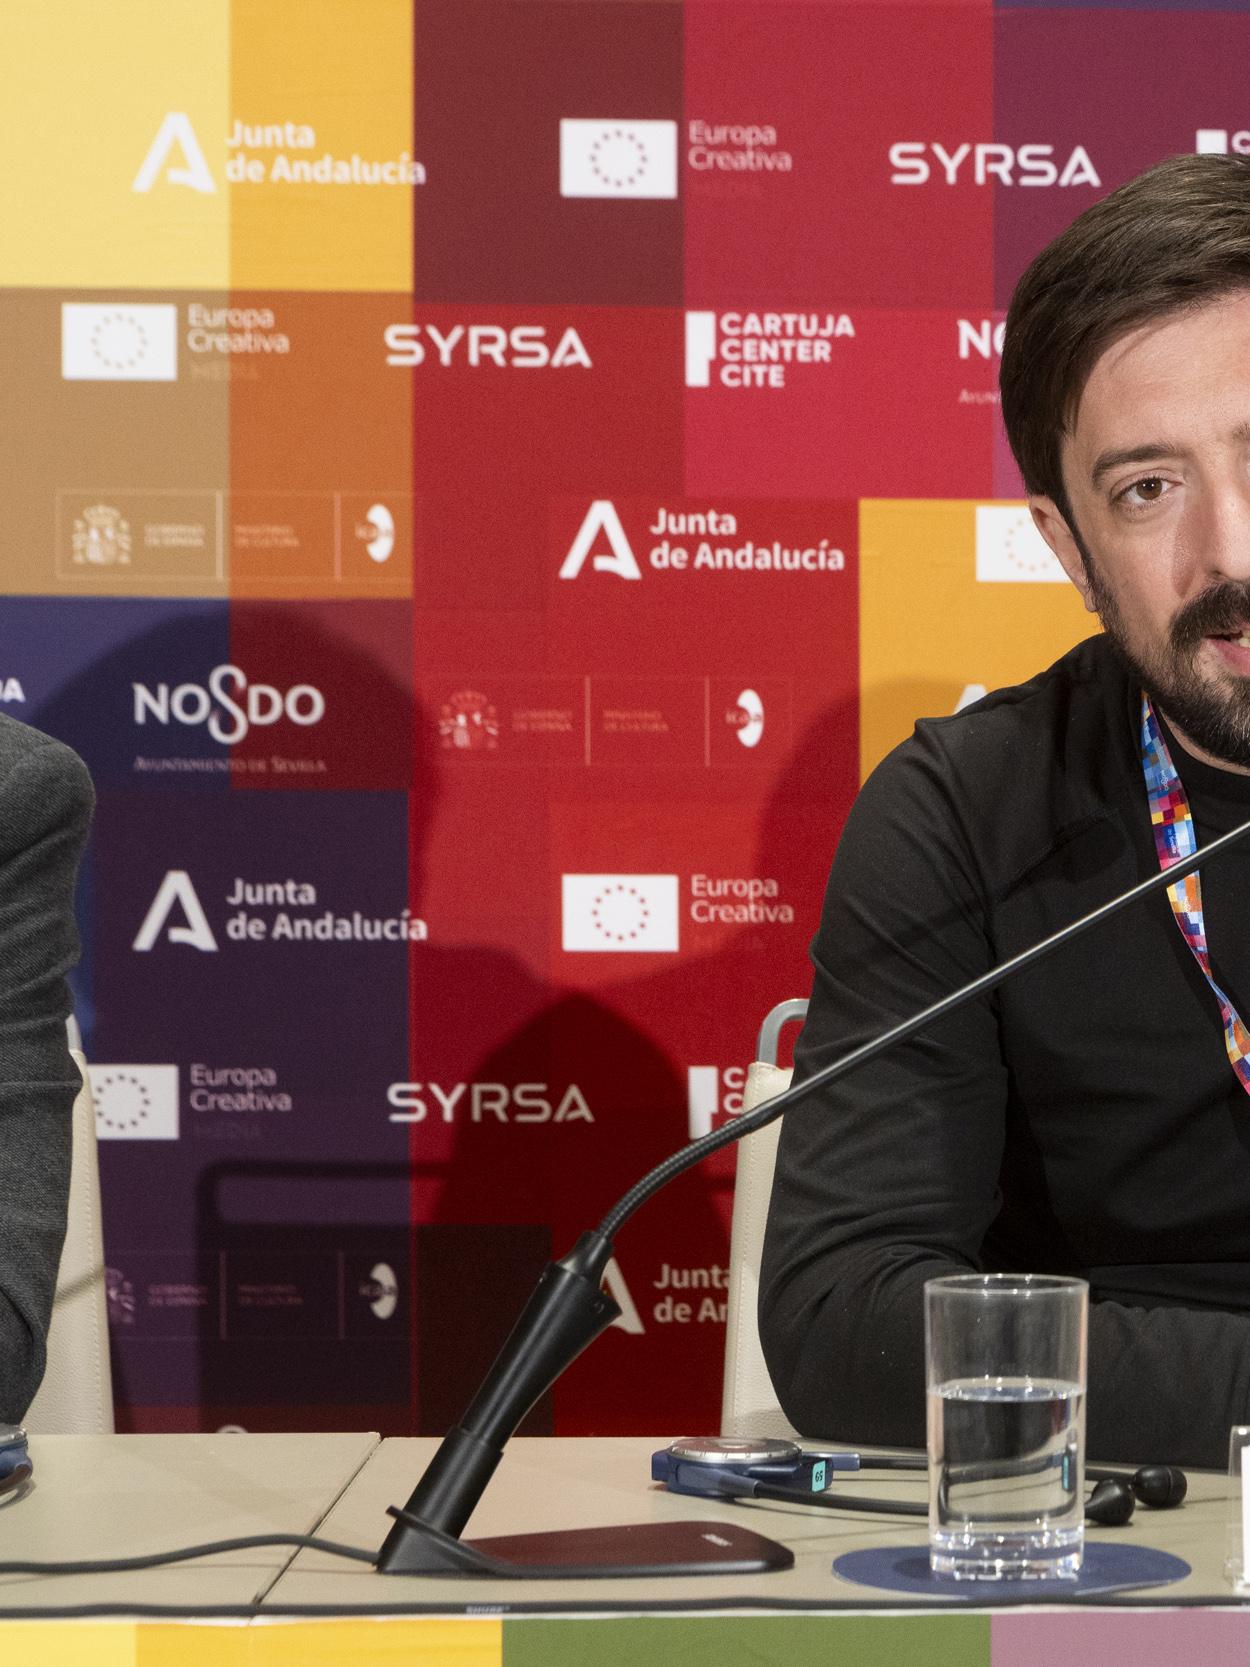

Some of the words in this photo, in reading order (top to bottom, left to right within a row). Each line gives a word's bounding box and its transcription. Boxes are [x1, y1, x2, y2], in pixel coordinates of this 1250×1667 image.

[227, 122, 316, 148] Junta
[690, 121, 778, 146] Europa
[227, 153, 263, 183] de
[271, 153, 427, 185] Andalucía
[689, 143, 793, 171] Creativa
[891, 144, 1101, 188] SYRSA
[190, 305, 276, 330] Europa
[721, 314, 856, 338] CARTUJA
[188, 327, 290, 354] Creativa
[386, 326, 593, 368] SYRSA
[721, 339, 832, 363] CENTER
[721, 365, 785, 388] CITE
[651, 509, 737, 535] Junta
[651, 542, 689, 570] de
[695, 541, 845, 571] Andalucía
[228, 879, 317, 906] Junta
[692, 875, 779, 902] Europa
[691, 898, 795, 924] Creativa
[228, 913, 267, 941] de
[273, 911, 428, 941] Andalucía
[192, 1065, 277, 1092] Europa
[191, 1088, 293, 1112] Creativa
[389, 1084, 594, 1123] SYRSA
[655, 1297, 692, 1323] de
